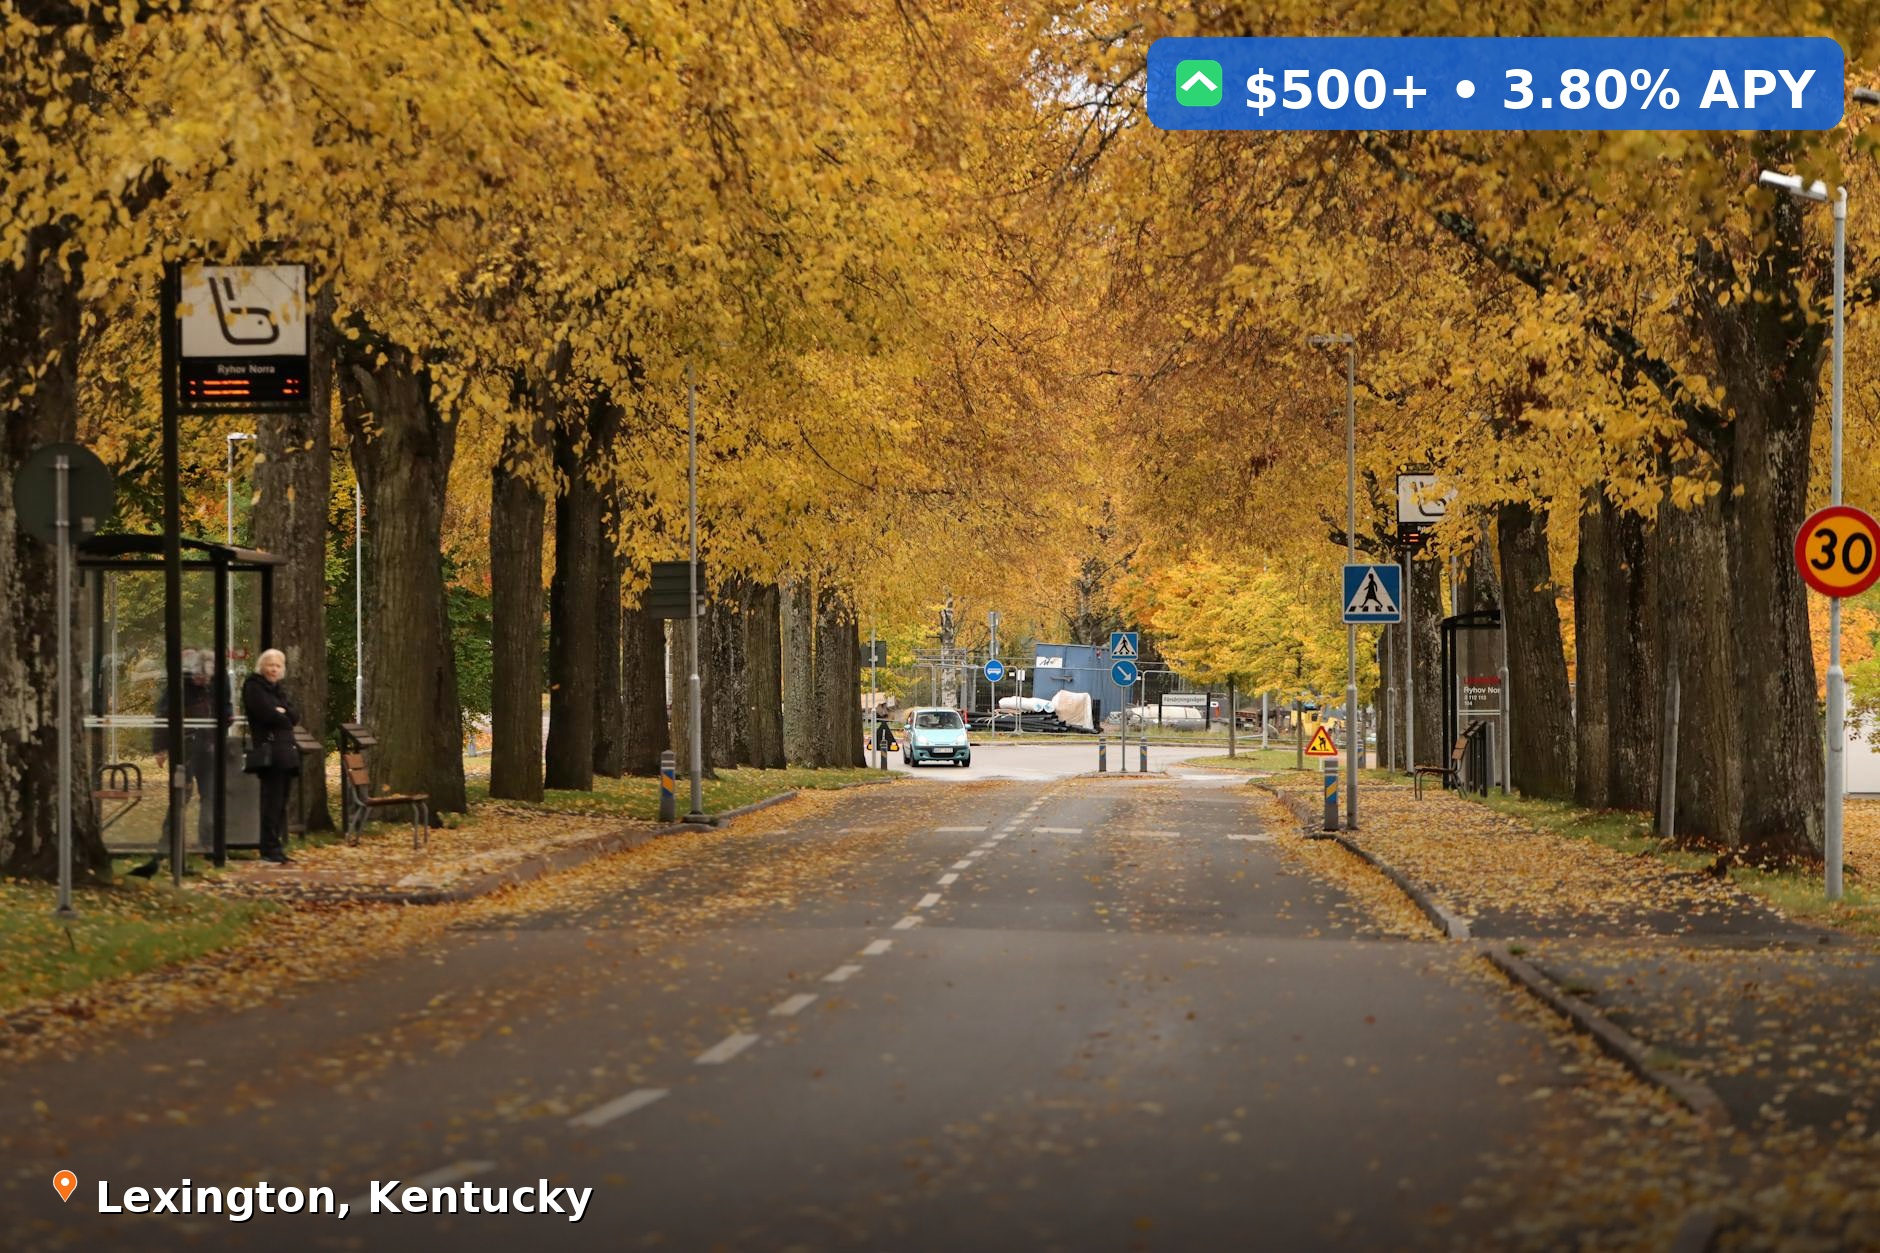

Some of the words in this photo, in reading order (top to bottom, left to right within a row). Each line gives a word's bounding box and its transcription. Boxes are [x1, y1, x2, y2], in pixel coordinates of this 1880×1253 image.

[217, 364, 246, 376] Ryhov
[249, 364, 275, 374] Norra
[1810, 528, 1873, 575] 30
[1463, 686, 1486, 695] Ryhov
[1487, 686, 1500, 694] Nor
